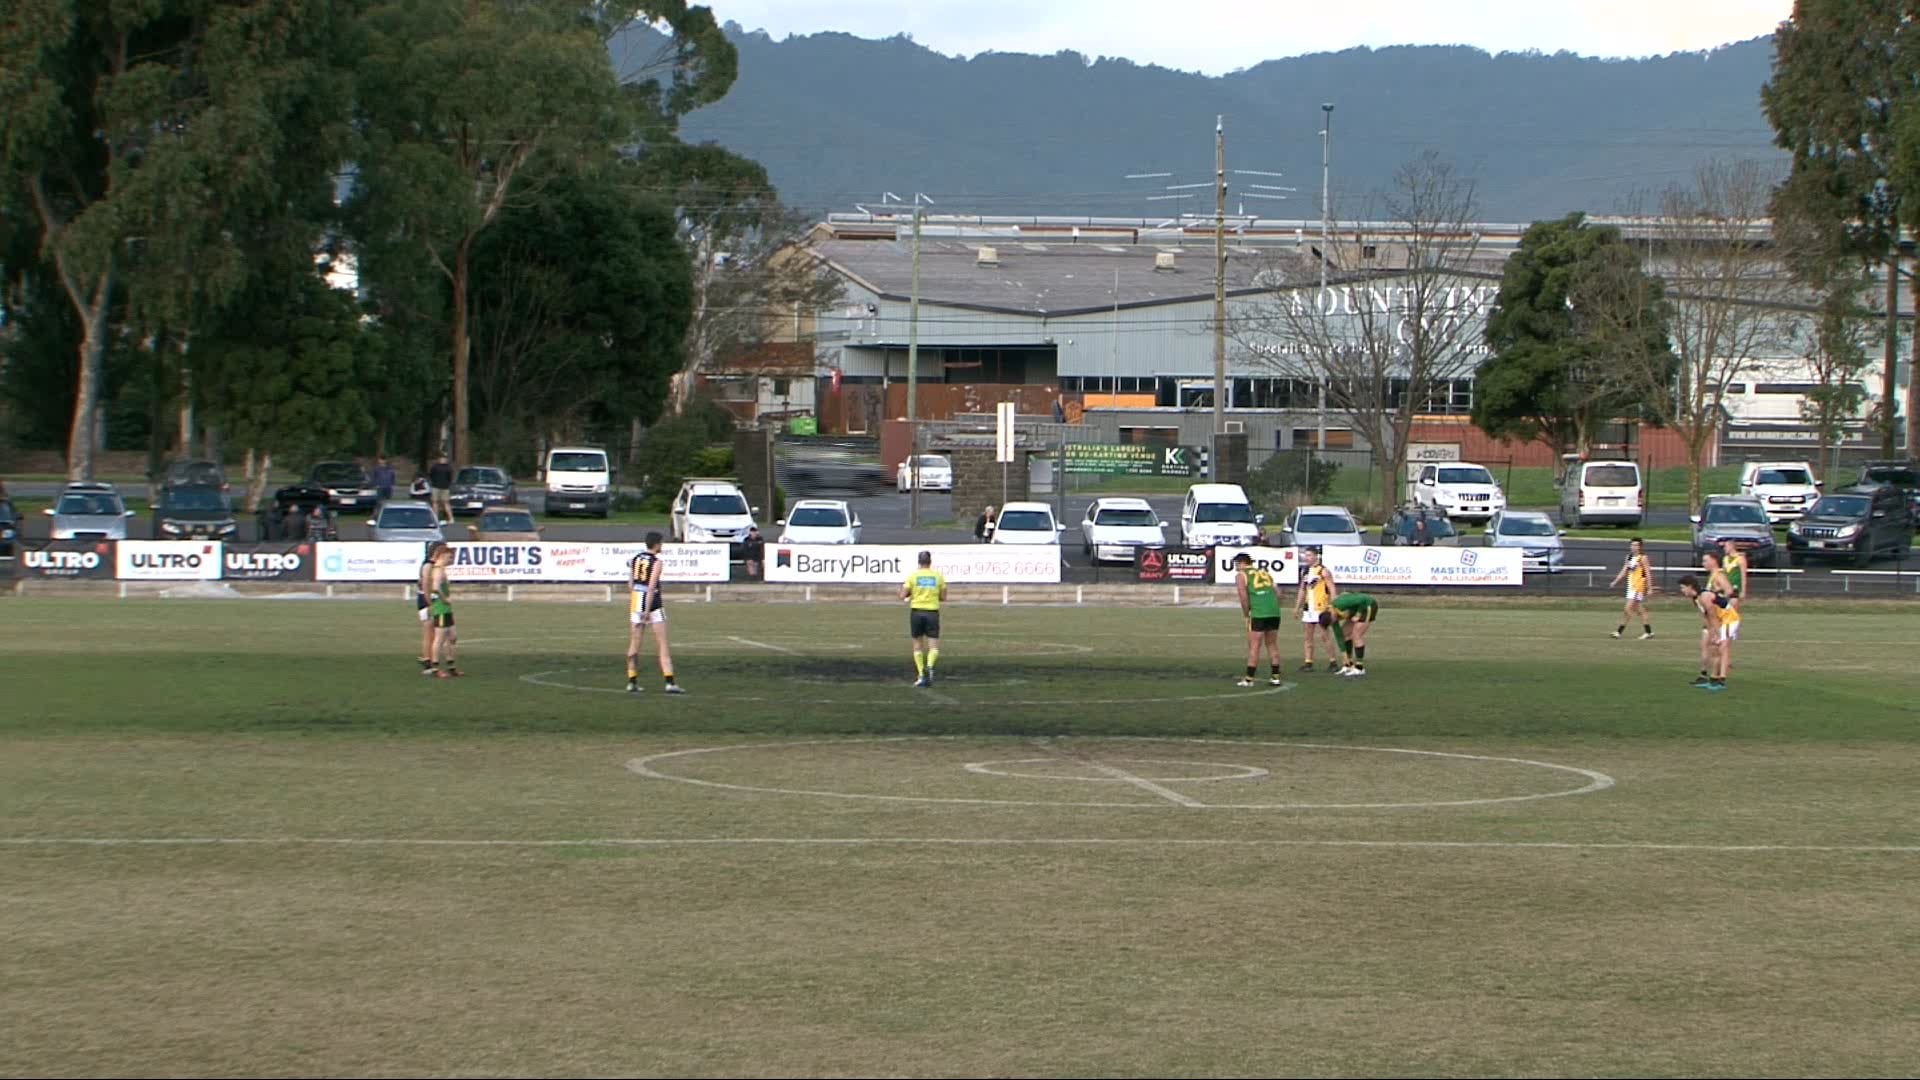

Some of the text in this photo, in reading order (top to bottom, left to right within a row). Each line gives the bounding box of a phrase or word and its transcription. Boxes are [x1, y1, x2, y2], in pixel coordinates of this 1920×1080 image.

[24, 551, 99, 568] ULTRO
[131, 554, 202, 568] ULTRO
[226, 553, 301, 570] ULTRO
[797, 554, 901, 578] BarryPlant
[1167, 554, 1207, 564] ULTRO
[1221, 560, 1285, 572] URO
[975, 562, 1010, 576] 9762
